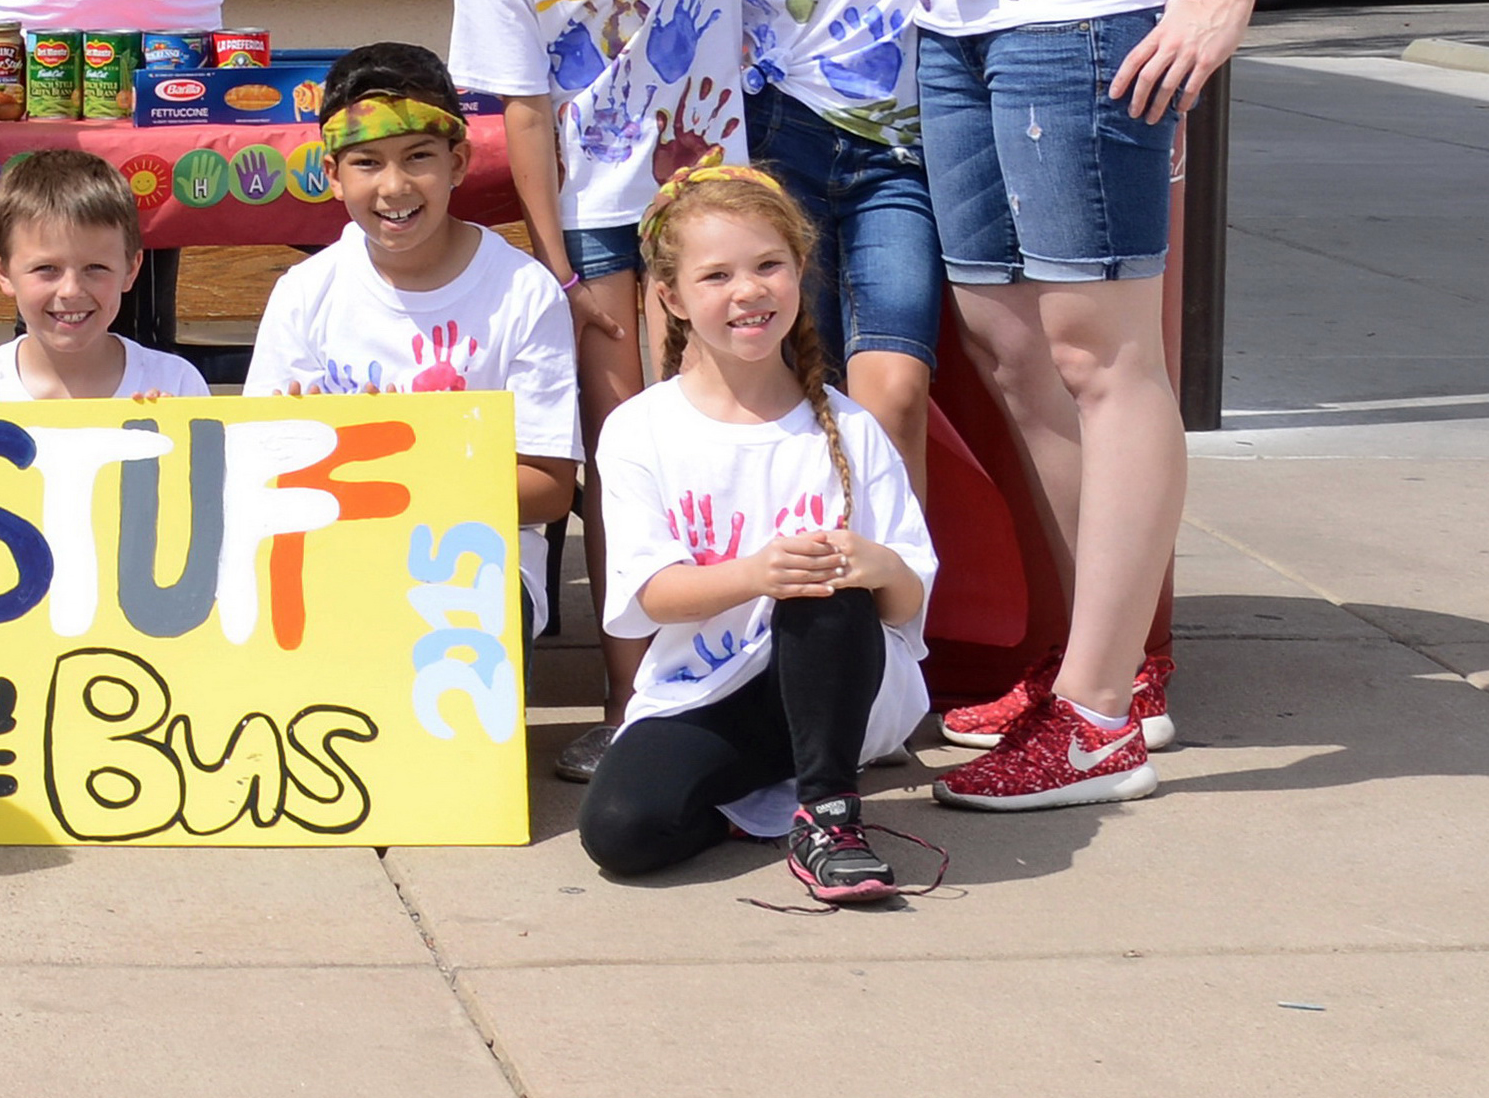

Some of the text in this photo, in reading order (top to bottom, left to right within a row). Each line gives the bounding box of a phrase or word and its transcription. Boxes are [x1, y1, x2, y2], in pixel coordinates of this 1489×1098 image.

[167, 84, 201, 95] Barilla
[151, 107, 209, 118] FETTUCCINE
[43, 646, 379, 843] Bus
